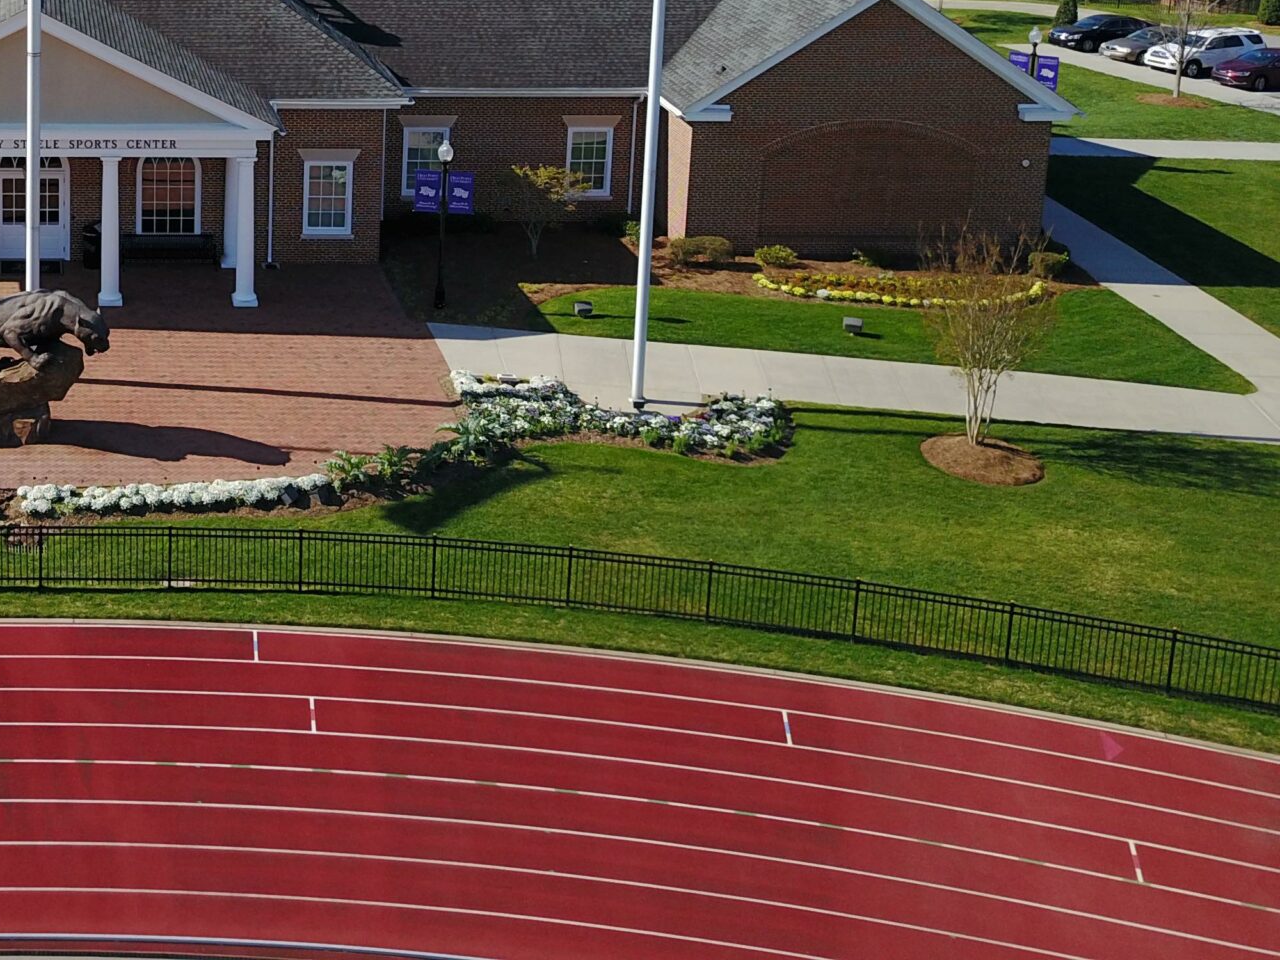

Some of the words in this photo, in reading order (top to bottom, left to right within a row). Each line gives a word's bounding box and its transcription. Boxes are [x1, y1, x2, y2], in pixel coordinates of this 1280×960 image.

[13, 139, 60, 150] STELE
[69, 139, 118, 150] SPORTS
[126, 139, 177, 150] CENTER
